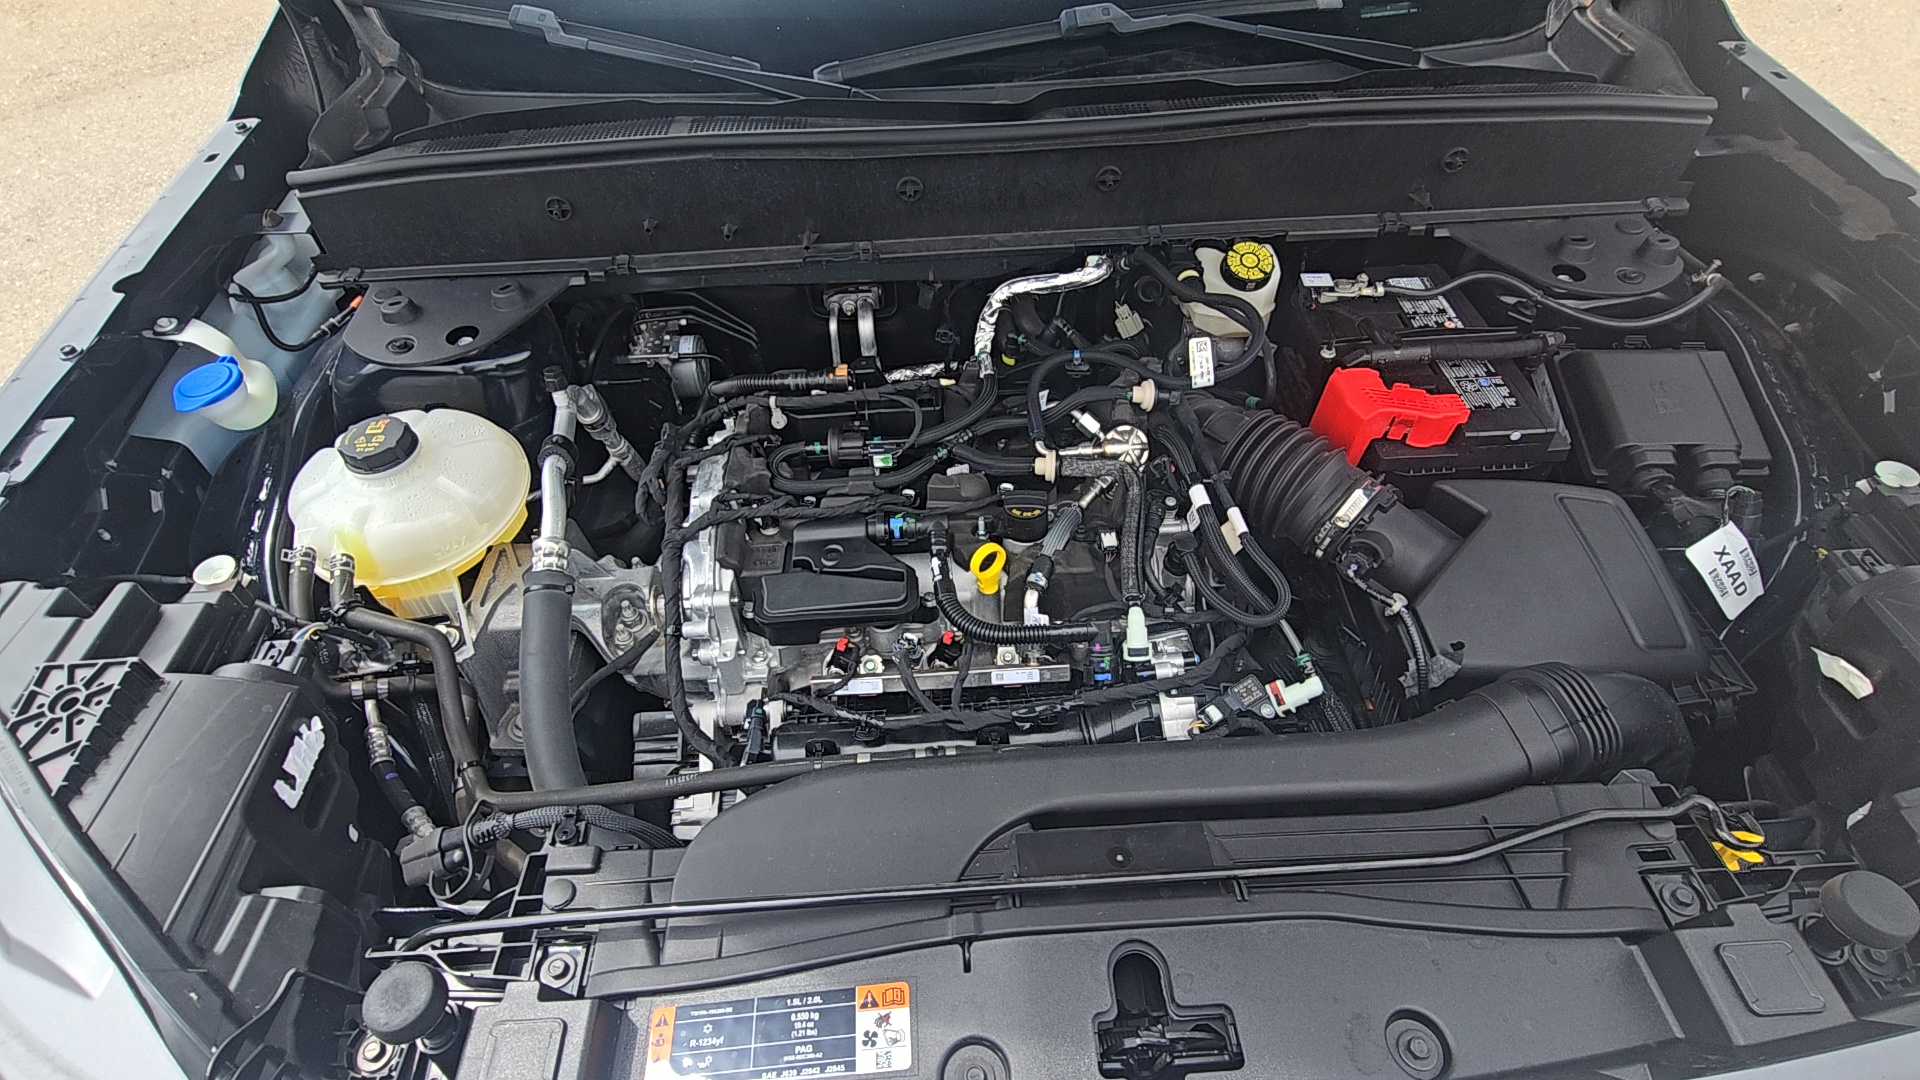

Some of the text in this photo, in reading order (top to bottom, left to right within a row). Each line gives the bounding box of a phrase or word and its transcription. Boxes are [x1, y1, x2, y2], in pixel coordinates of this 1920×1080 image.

[1713, 544, 1748, 597] XAAD
[790, 1011, 820, 1022] 0.550 kg
[689, 1035, 724, 1048] R-1234yf
[794, 1044, 813, 1054] PAG
[761, 1071, 778, 1080] SAE
[780, 1069, 798, 1079] J639
